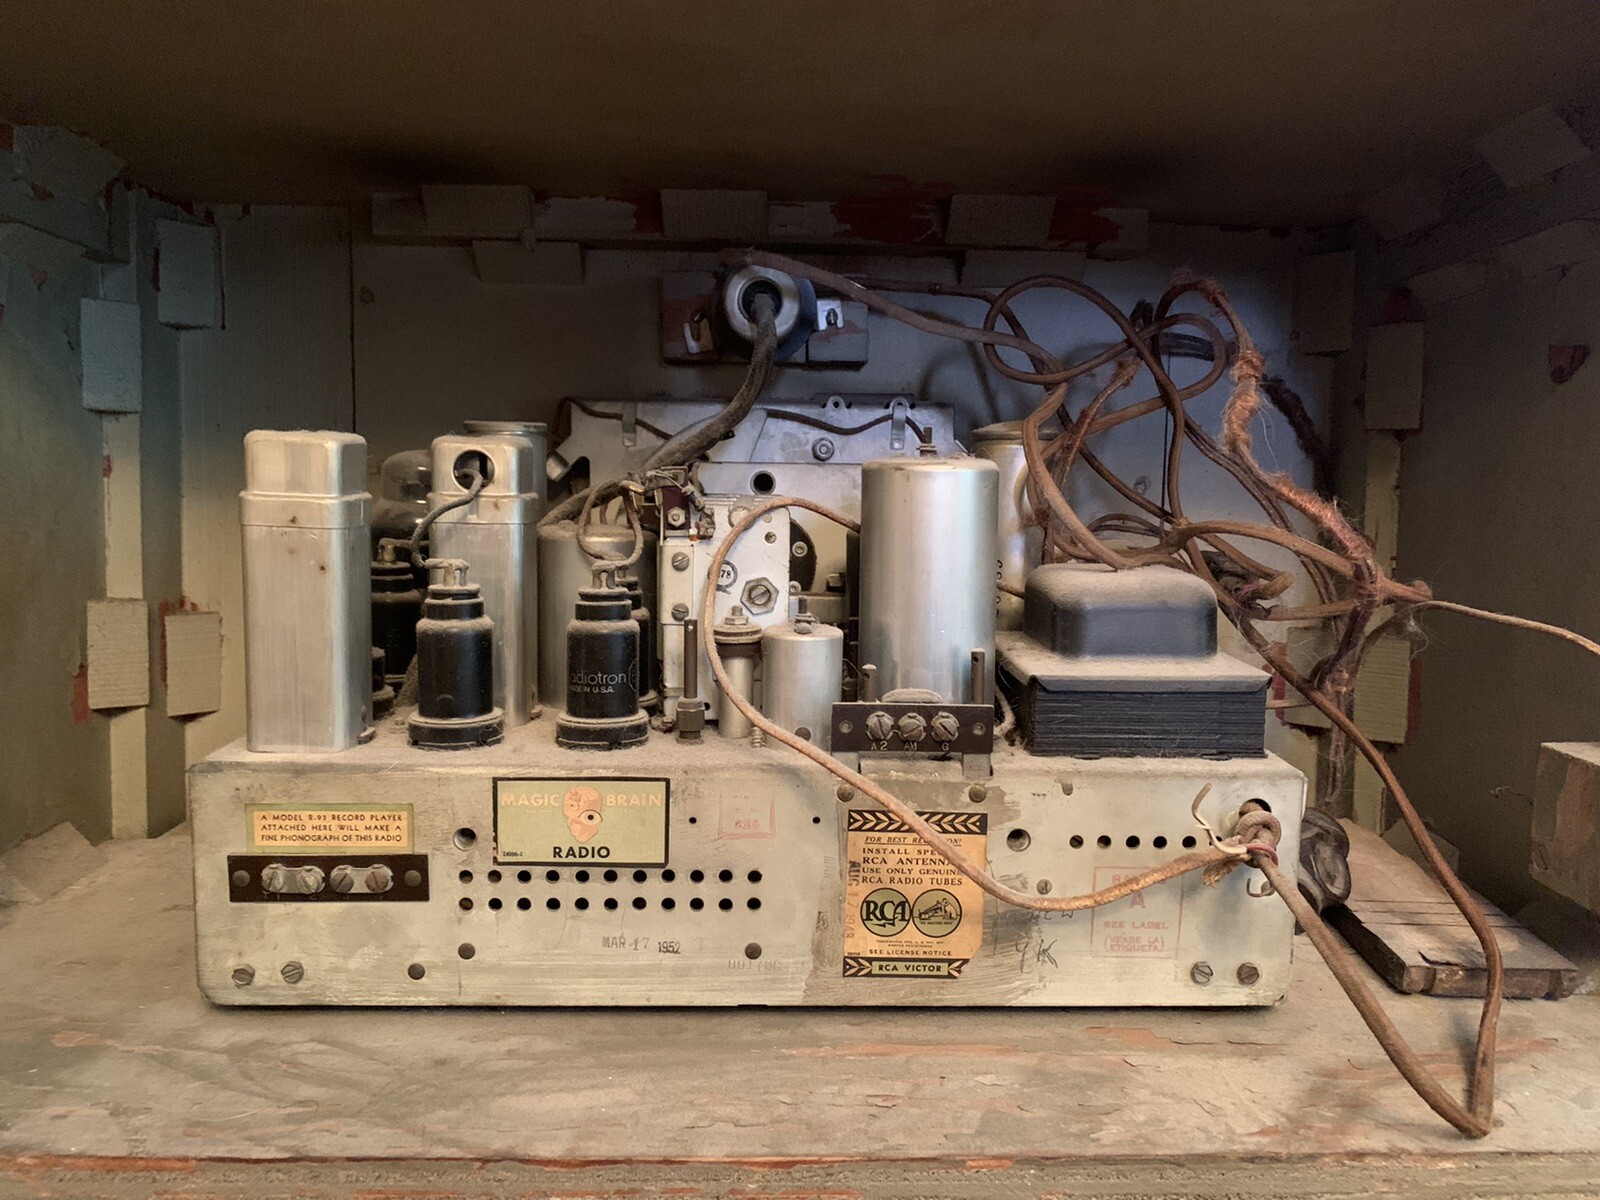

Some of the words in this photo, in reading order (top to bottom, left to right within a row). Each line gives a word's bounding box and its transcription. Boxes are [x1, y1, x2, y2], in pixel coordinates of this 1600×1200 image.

[570, 670, 627, 685] adiotron
[941, 741, 950, 751] G
[500, 793, 560, 807] MAGIC
[606, 793, 663, 807] BRAIN
[261, 824, 307, 832] ATTACHED
[312, 824, 333, 832] HERE
[338, 824, 359, 832] WILL
[364, 824, 390, 832] MAKE
[395, 824, 402, 832] A
[261, 834, 278, 842] FINE
[280, 834, 339, 842] PHONOGRAPH
[342, 834, 352, 842] OF
[355, 834, 373, 842] THIS
[375, 834, 403, 842] RADIO
[887, 836, 908, 844] BEST
[552, 846, 611, 859] RADIO
[862, 847, 910, 855] INSTALL
[862, 857, 888, 865] RCA
[847, 860, 861, 887] AUG
[886, 867, 914, 875] ONLY
[862, 876, 883, 884] RCA
[889, 876, 924, 885] RADIO
[929, 877, 963, 886] TUBES
[862, 900, 909, 923] RCA
[1103, 920, 1126, 929] SEE
[1131, 921, 1169, 930] LABEL
[602, 936, 625, 949] MAR
[658, 941, 682, 954] 1952
[878, 964, 899, 972] RCA
[904, 964, 942, 972] VICTOR
